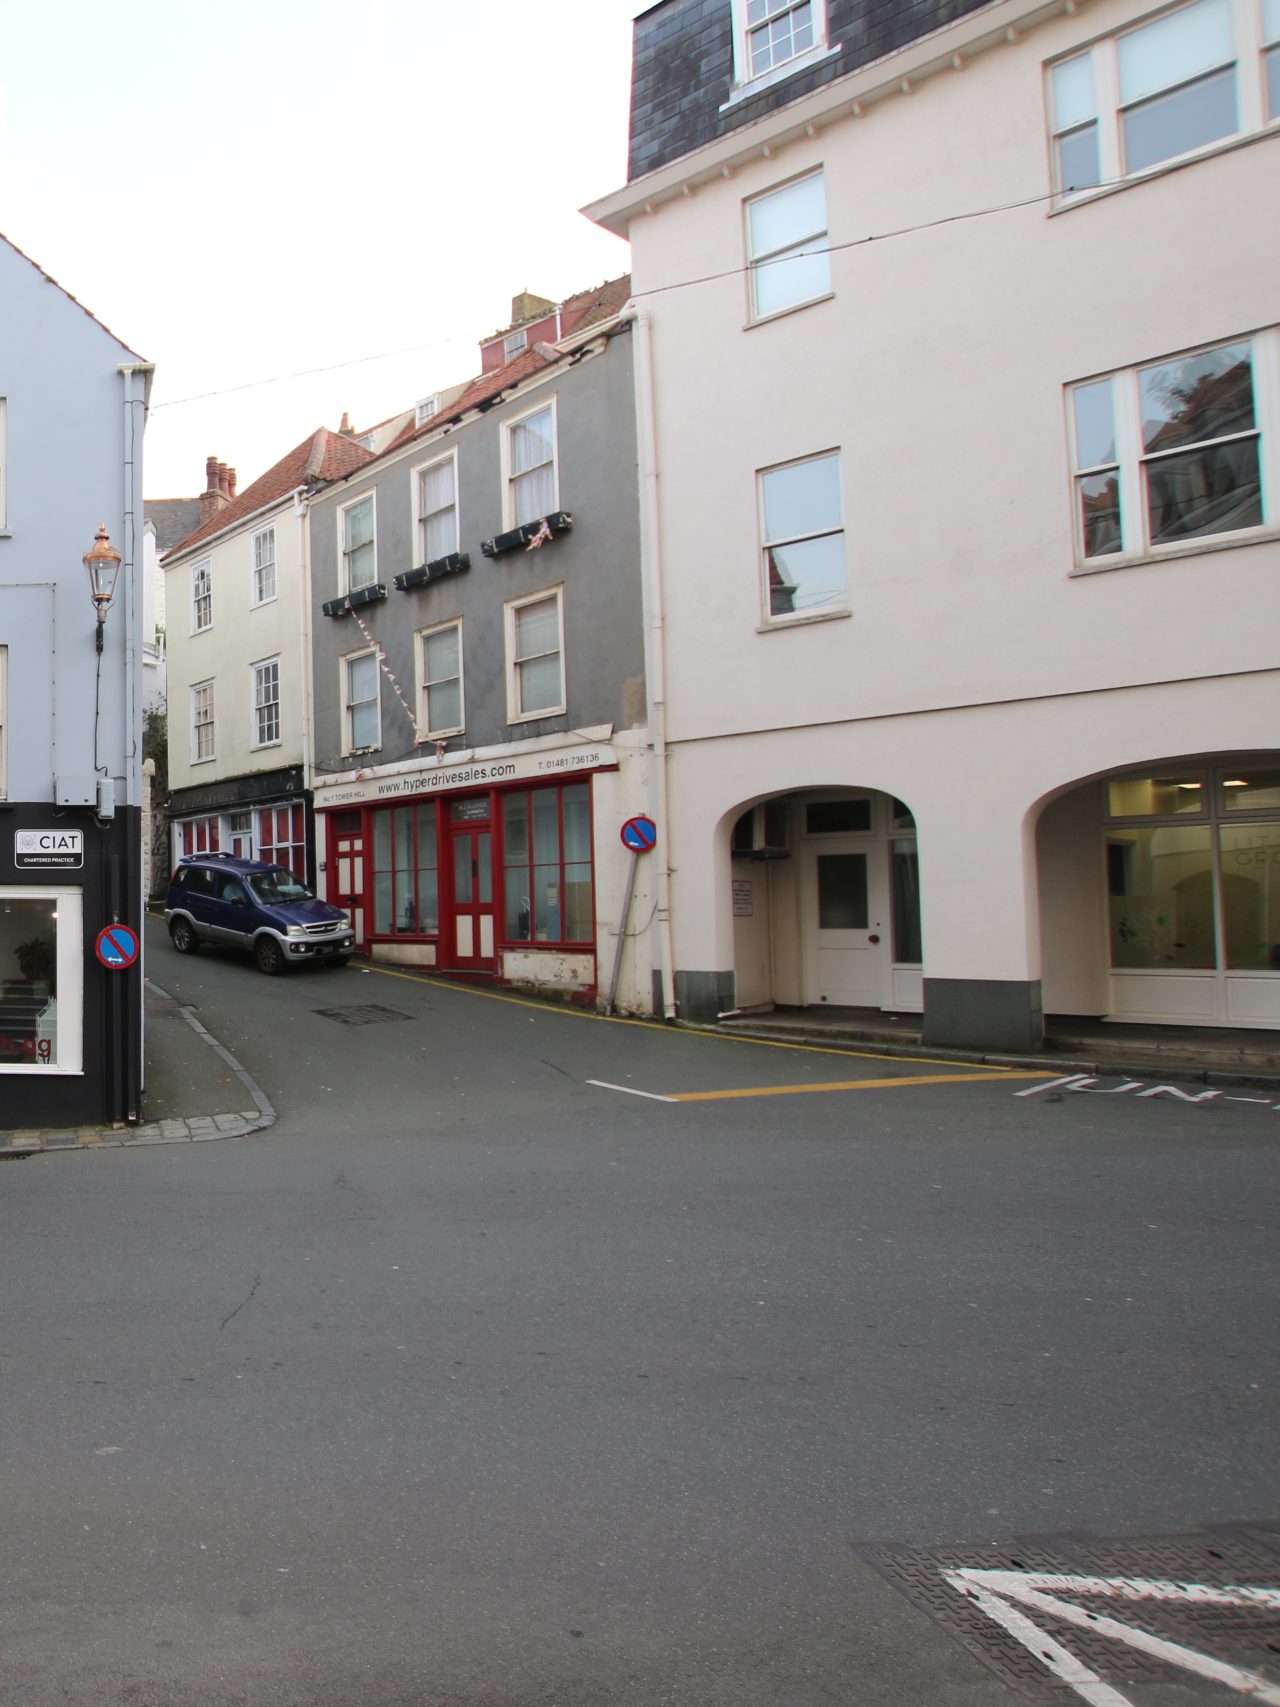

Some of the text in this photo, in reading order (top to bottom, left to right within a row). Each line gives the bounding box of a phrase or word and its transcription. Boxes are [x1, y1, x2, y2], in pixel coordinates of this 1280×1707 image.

[546, 758, 569, 768] 01481
[571, 752, 600, 765] 736136
[378, 762, 516, 794] www.hyperdrivesales.com
[335, 792, 353, 800] TOWER
[39, 835, 79, 849] CIAT
